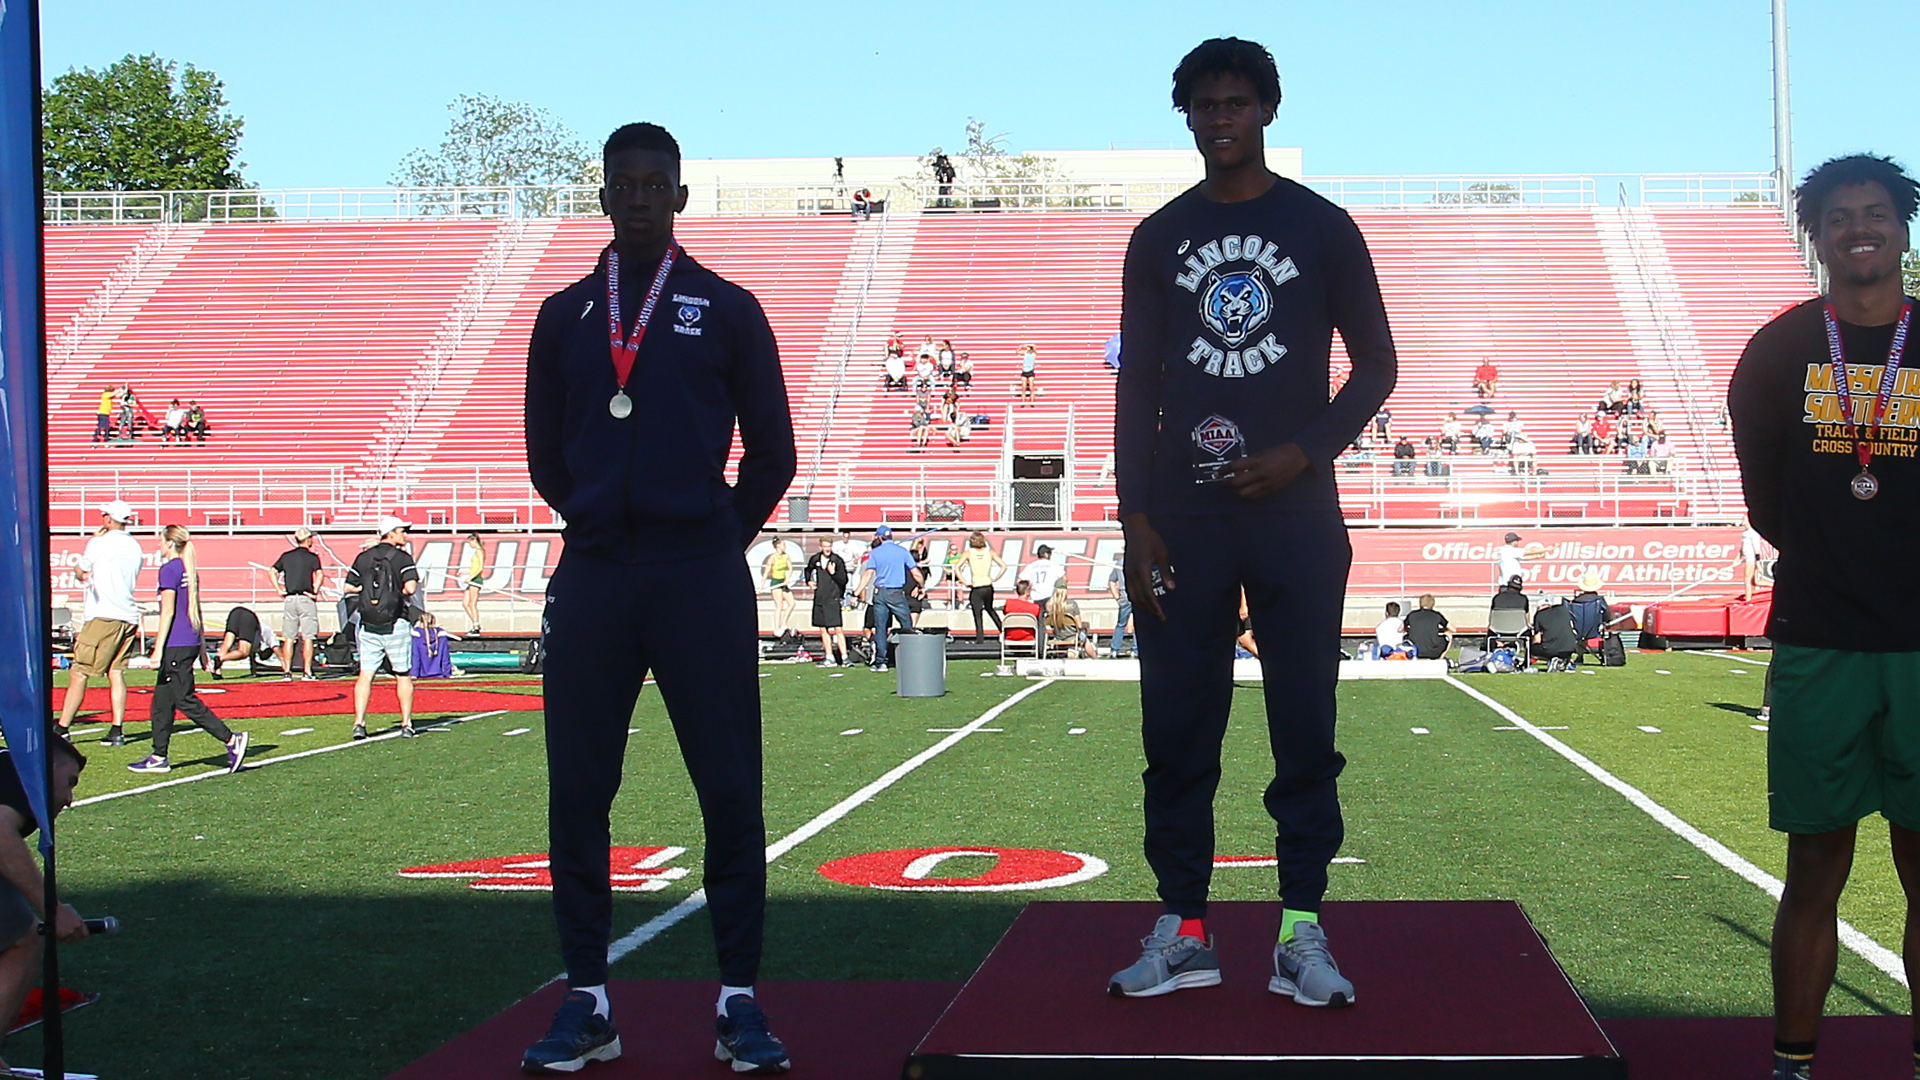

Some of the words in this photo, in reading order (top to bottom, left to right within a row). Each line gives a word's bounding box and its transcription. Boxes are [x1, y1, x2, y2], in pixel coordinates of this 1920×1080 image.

[1175, 235, 1300, 293] LINCOLN
[1187, 332, 1288, 378] TRACK
[1804, 363, 1920, 398] MSSOUR
[1880, 427, 1918, 442] FIELD
[1812, 439, 1853, 454] CROSS
[1859, 441, 1918, 458] UNTRY
[1422, 542, 1501, 561] Offici
[1642, 541, 1735, 559] Center
[1035, 571, 1047, 583] 17
[1615, 563, 1735, 582] Athletics
